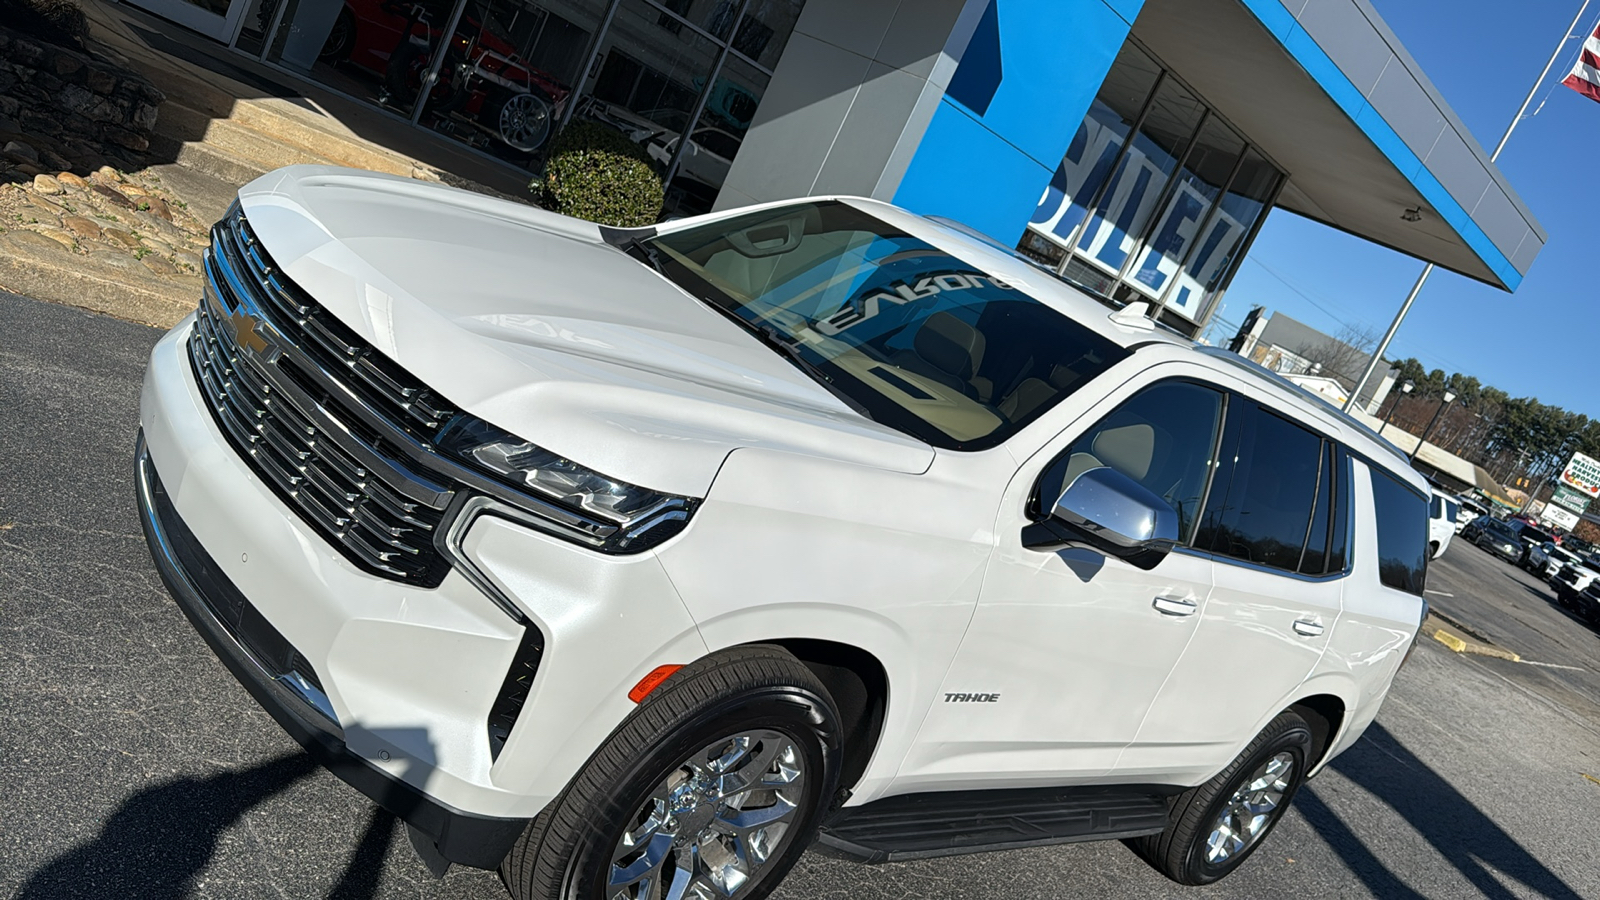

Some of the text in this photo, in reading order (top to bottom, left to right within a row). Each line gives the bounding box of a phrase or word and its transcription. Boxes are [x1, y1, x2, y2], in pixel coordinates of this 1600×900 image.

[1572, 459, 1600, 475] HEALTHY
[1571, 471, 1600, 488] PRODUC
[944, 693, 1001, 703] TAHOE
